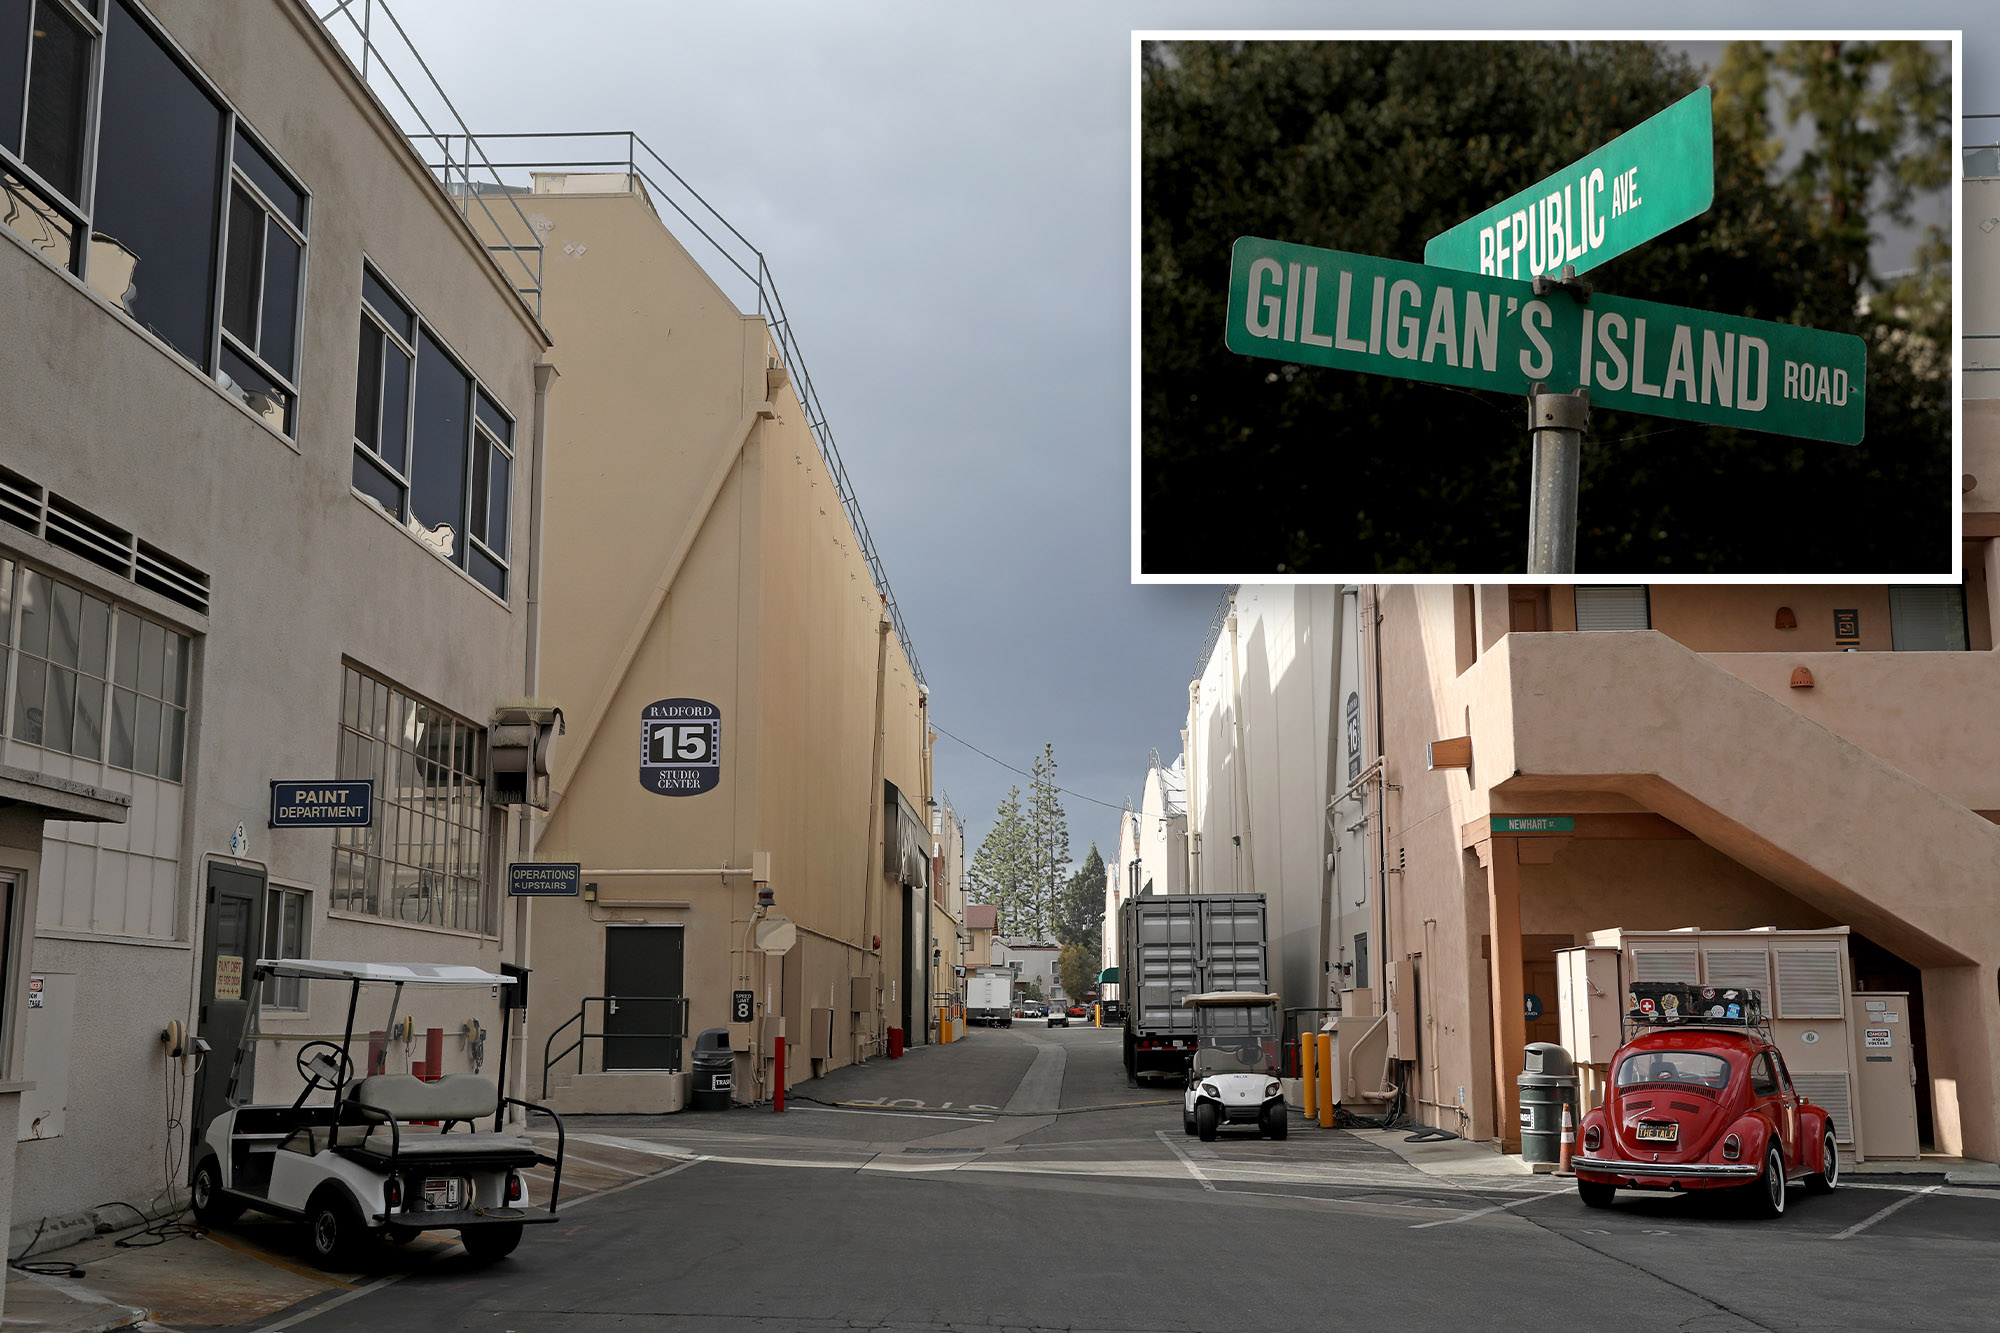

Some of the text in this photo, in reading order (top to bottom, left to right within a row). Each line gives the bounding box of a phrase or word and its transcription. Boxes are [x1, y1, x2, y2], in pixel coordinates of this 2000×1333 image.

[1479, 166, 1642, 279] REPUBLIC AVE.
[1245, 256, 1848, 412] GILLIGAN'S ISLAND ROAD
[650, 706, 713, 717] RADFORD
[1348, 718, 1359, 753] 16
[654, 726, 707, 760] 15
[659, 769, 700, 780] STUDIO
[657, 779, 701, 789] CENTER
[295, 790, 350, 804] PAINT
[279, 806, 364, 818] DEPARTMENT
[1508, 819, 1547, 830] NEWHART
[238, 825, 243, 838] 3
[232, 836, 237, 848] 2
[242, 839, 247, 850] 1
[513, 869, 576, 880] OPERATIONS
[521, 881, 567, 890] UPSTAIRS
[738, 1003, 749, 1017] 8
[1640, 1129, 1675, 1139] THE TALK
